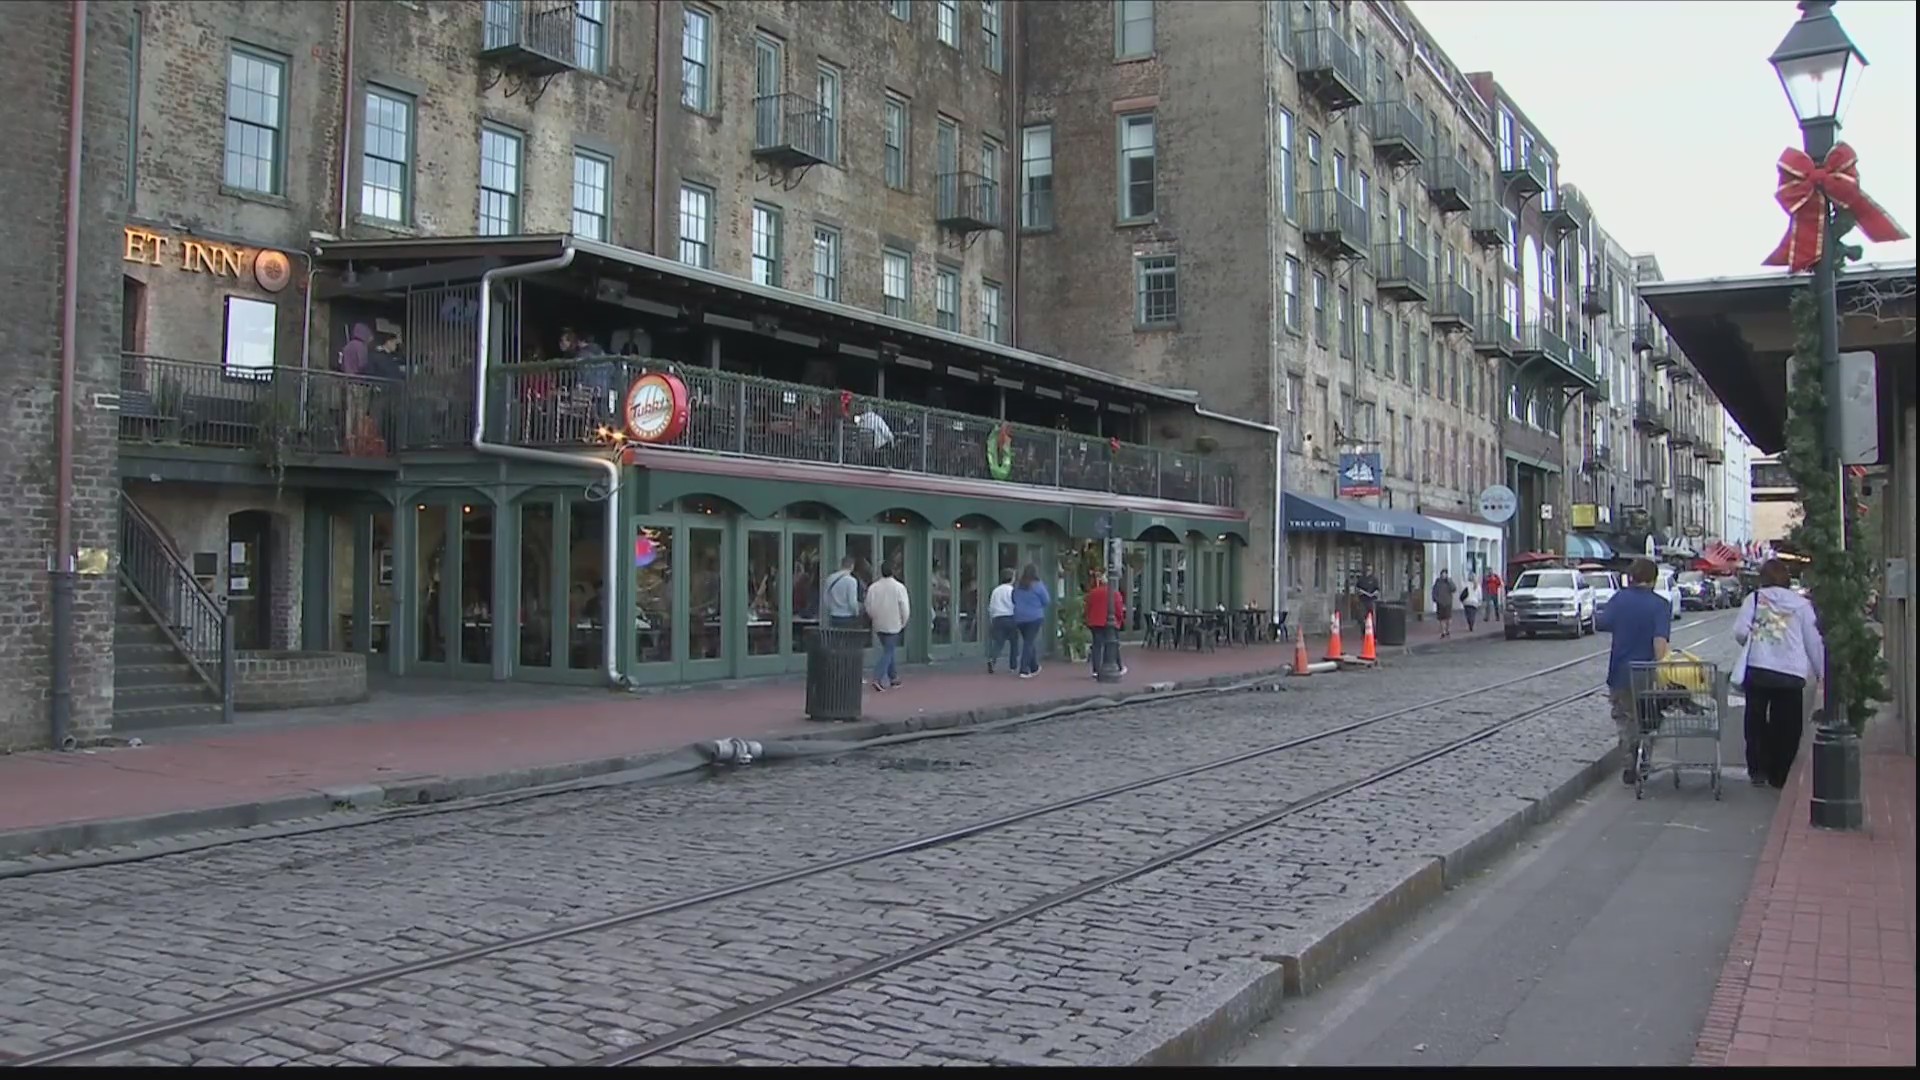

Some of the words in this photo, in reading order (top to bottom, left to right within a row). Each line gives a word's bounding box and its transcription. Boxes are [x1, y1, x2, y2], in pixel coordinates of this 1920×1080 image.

[124, 227, 168, 266] ET
[180, 240, 244, 278] INN
[1313, 520, 1341, 528] GRITS
